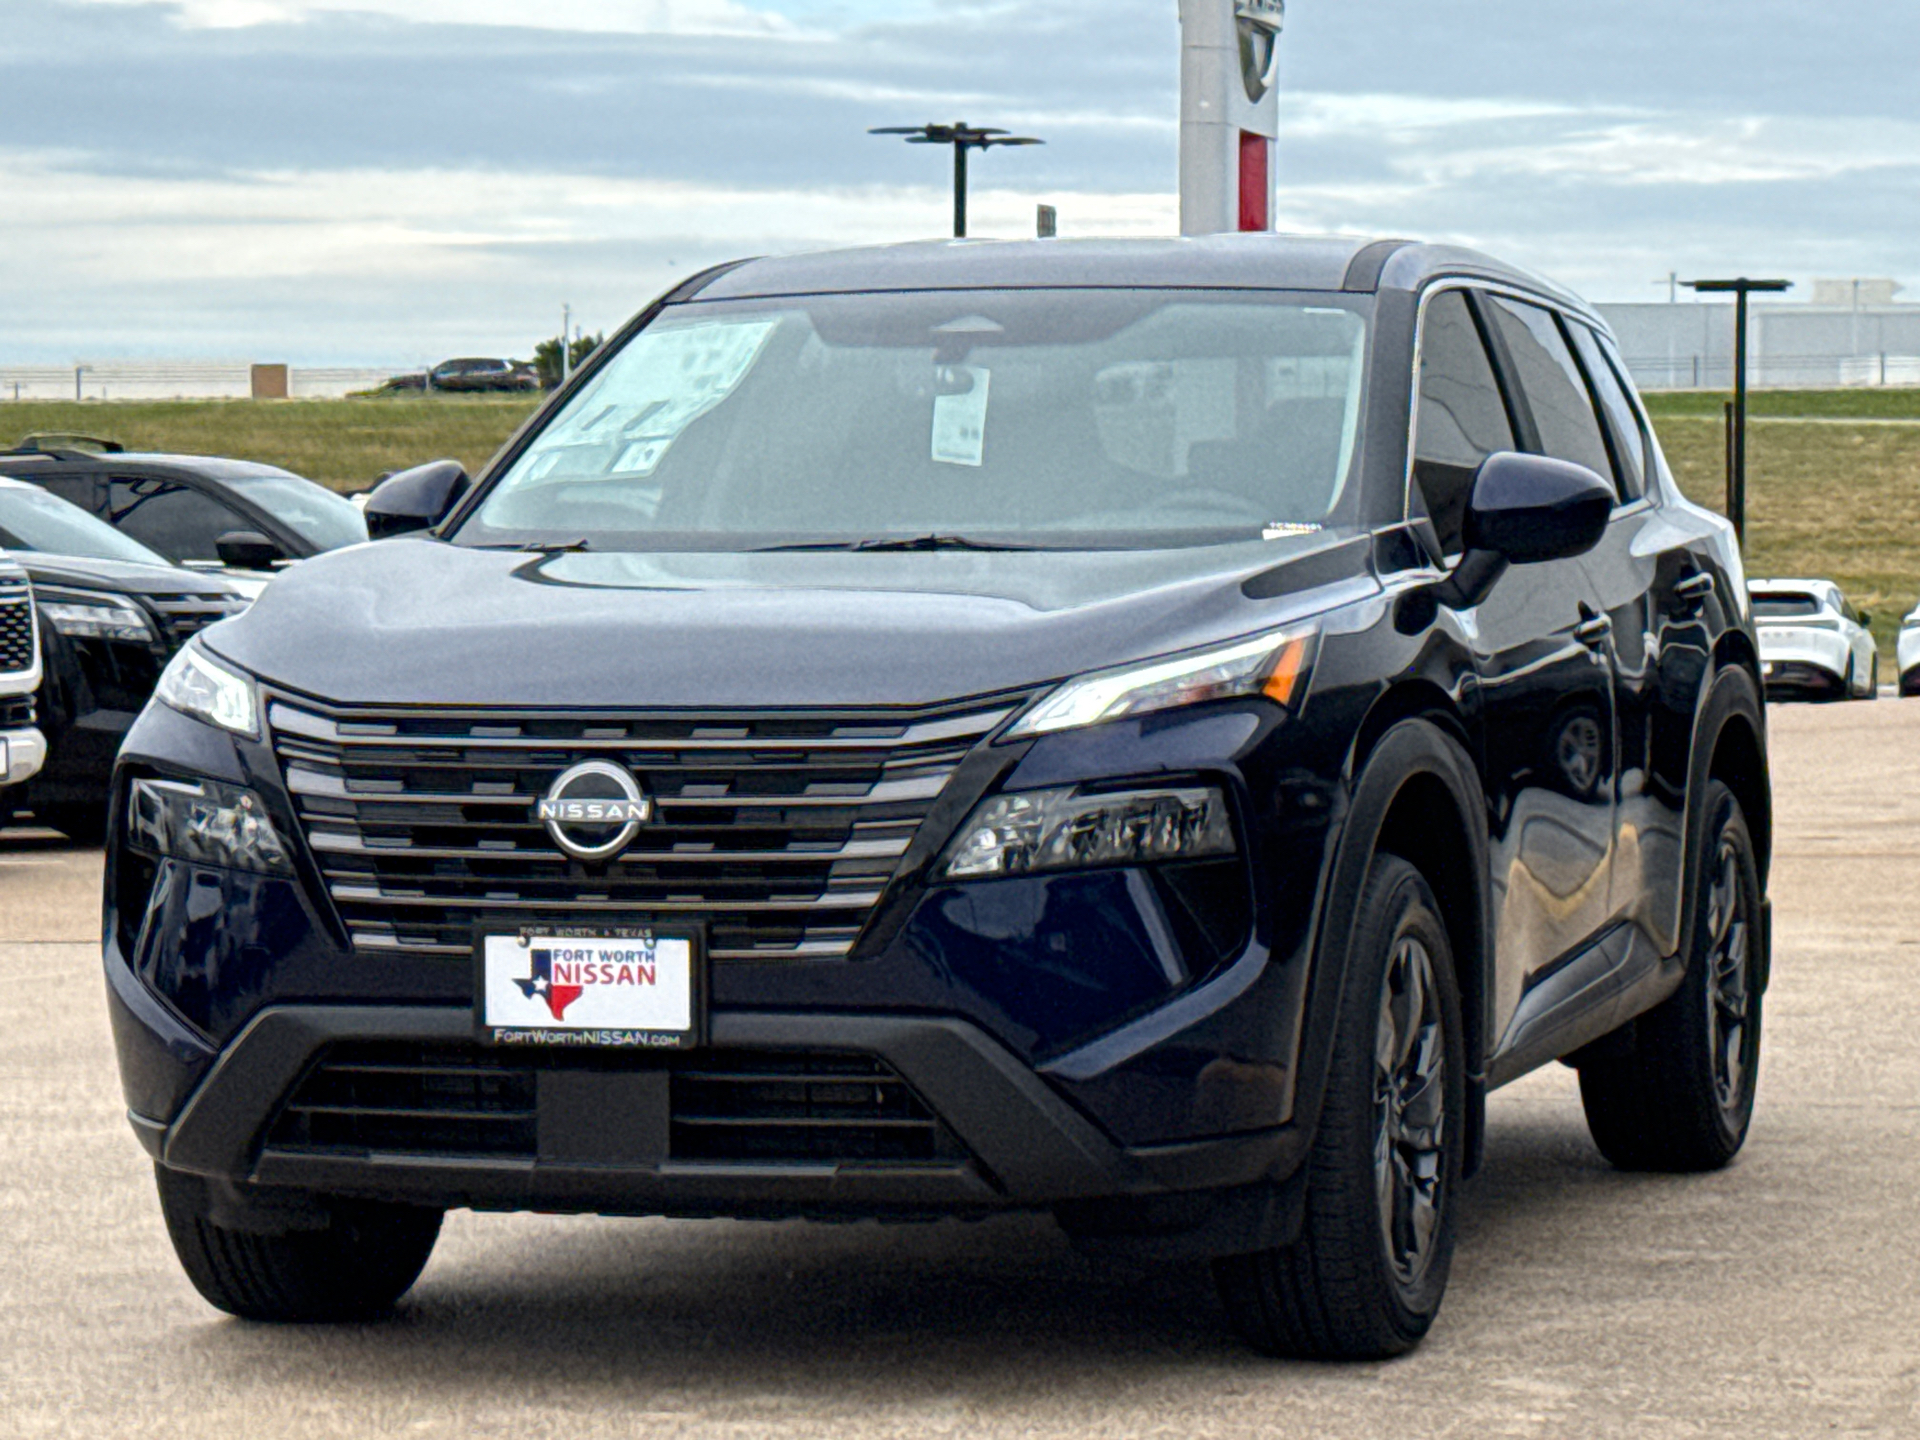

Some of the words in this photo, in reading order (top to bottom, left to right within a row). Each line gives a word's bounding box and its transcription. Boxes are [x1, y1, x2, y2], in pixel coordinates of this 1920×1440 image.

[540, 803, 645, 819] NISSAN
[519, 926, 549, 937] FORT
[555, 927, 596, 938] WORTH
[614, 928, 651, 938] TEXAS
[553, 949, 593, 962] FORT
[598, 950, 656, 963] WORTH
[554, 963, 656, 986] NISSAN
